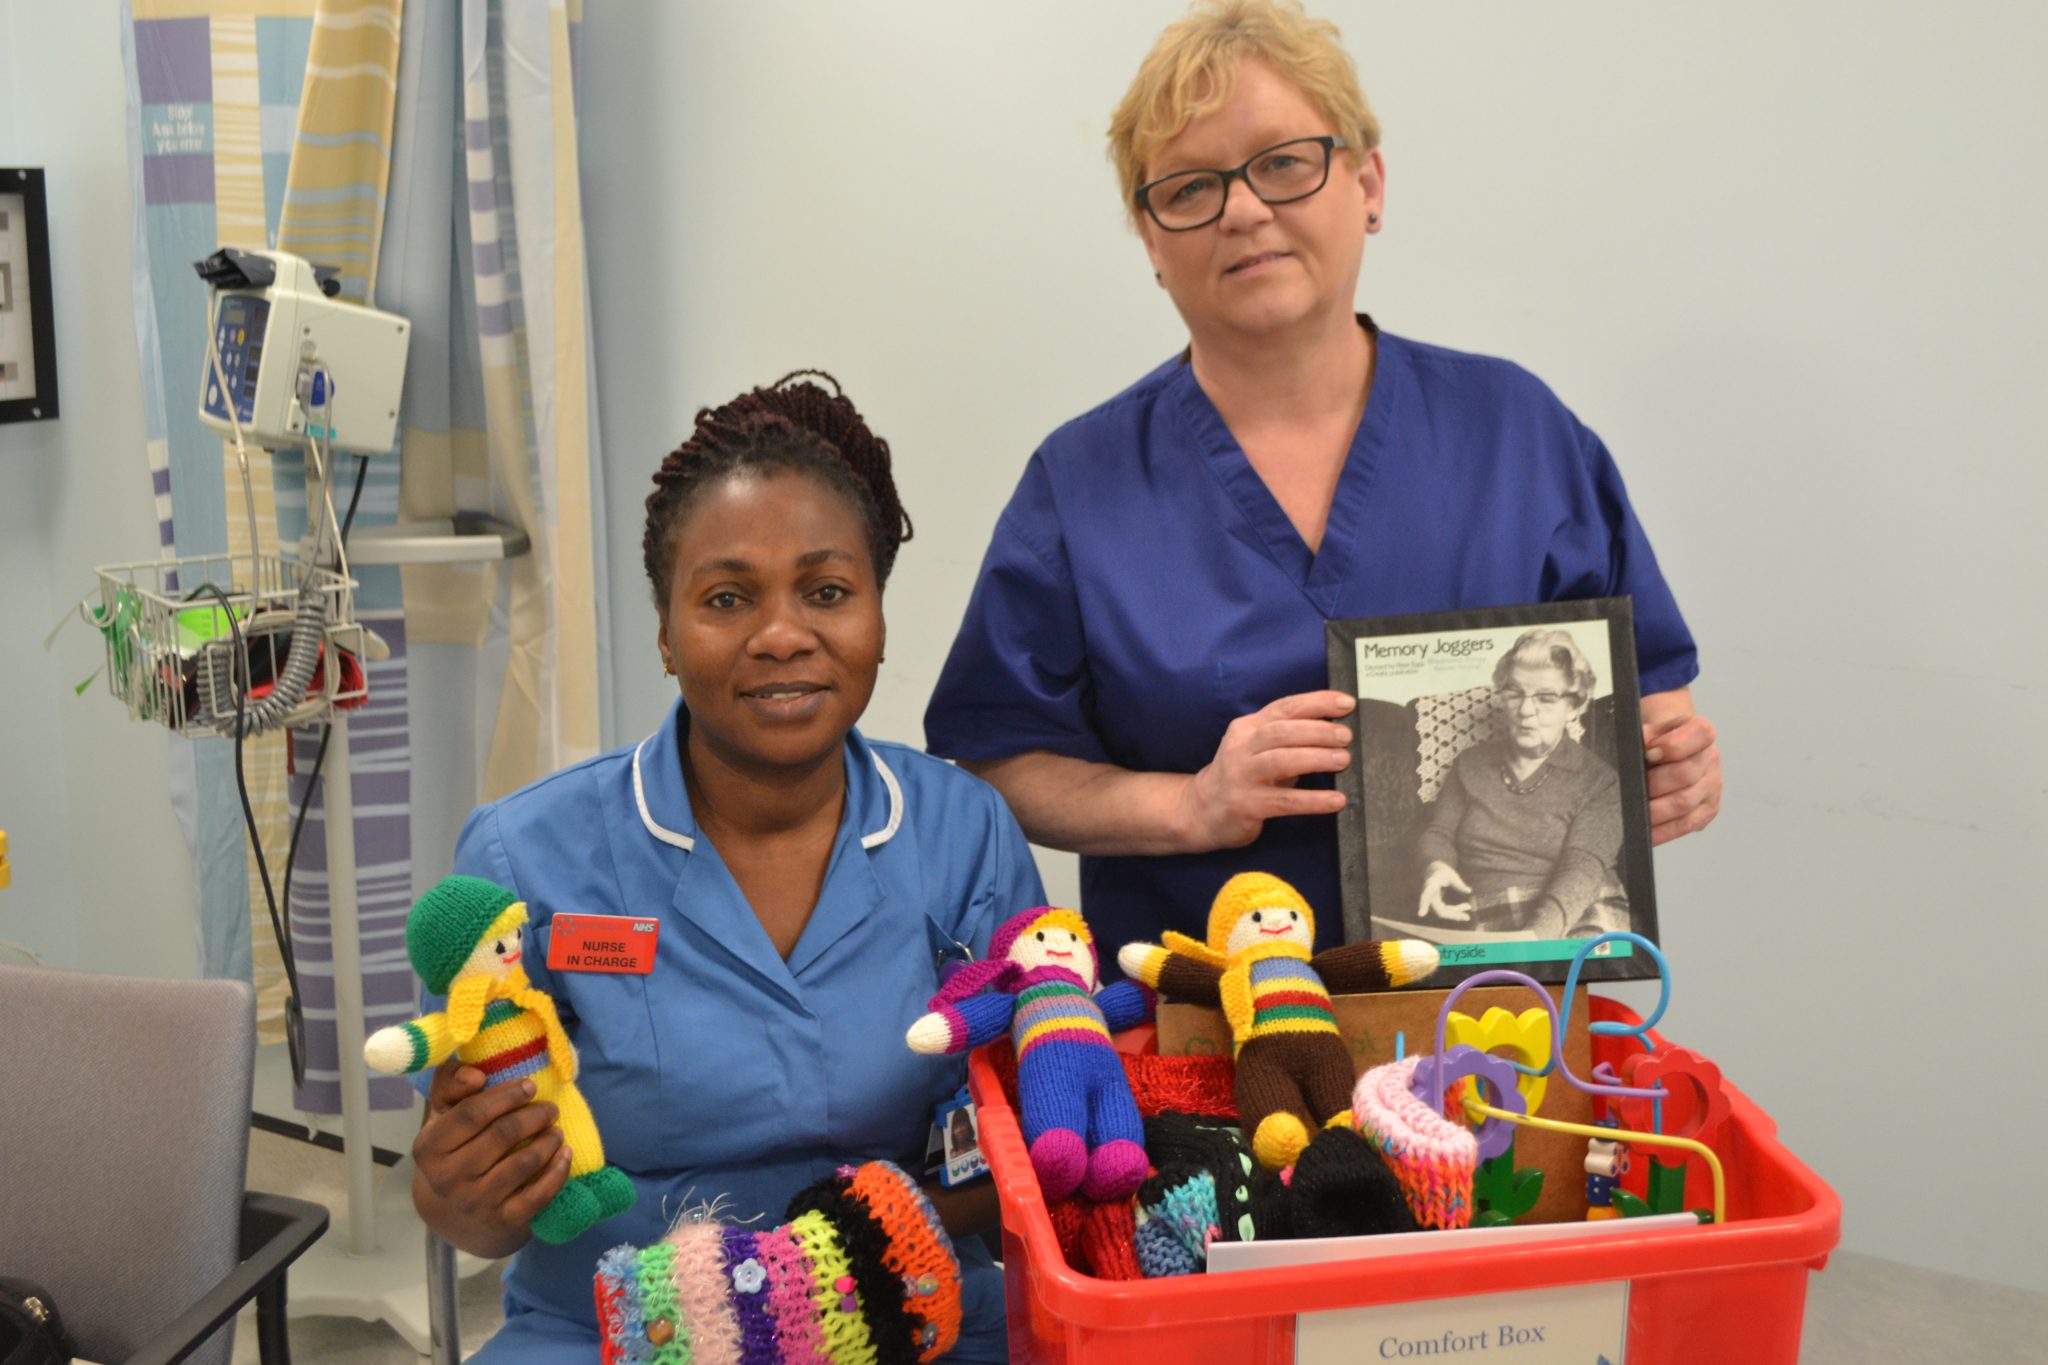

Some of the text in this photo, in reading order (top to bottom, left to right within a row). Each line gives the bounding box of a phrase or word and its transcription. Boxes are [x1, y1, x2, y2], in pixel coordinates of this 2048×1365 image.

[1364, 638, 1494, 659] Memory Joggers
[632, 922, 655, 933] NHS
[582, 941, 626, 952] NURSE
[1439, 945, 1487, 962] tryside
[567, 955, 637, 968] IN CHARGE
[1379, 1325, 1546, 1359] Comfort Box
